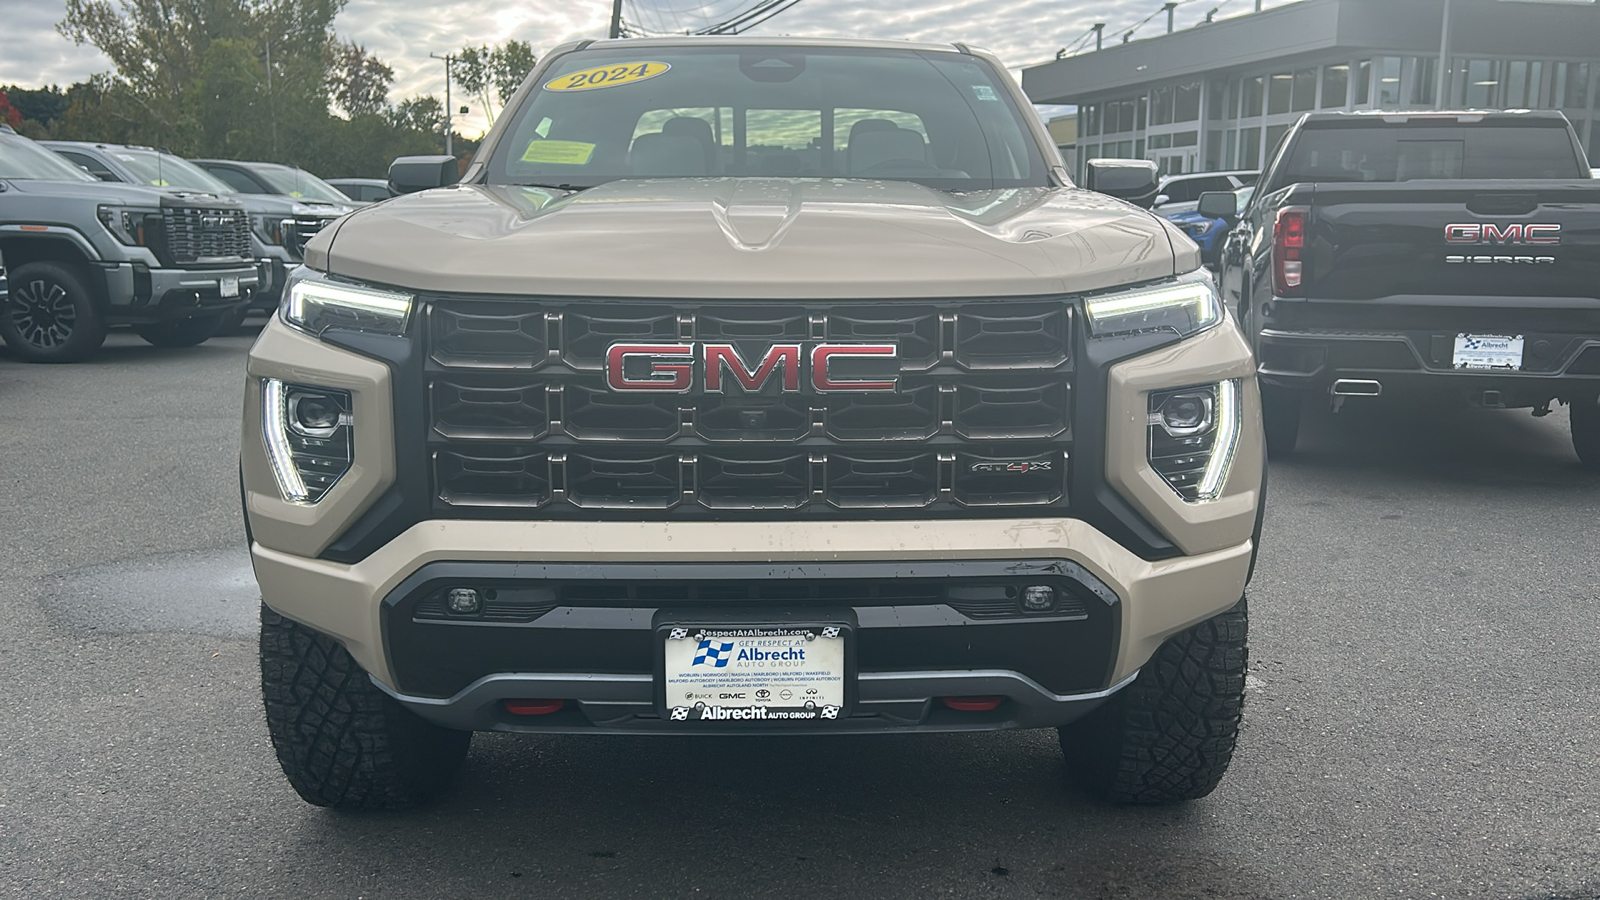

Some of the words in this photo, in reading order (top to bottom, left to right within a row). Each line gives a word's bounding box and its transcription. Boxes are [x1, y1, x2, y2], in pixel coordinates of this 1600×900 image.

[566, 63, 650, 89] 2024
[1445, 223, 1561, 246] GMC
[1445, 255, 1555, 264] SIERRA
[606, 342, 899, 393] GMC
[970, 461, 1052, 474] AT4X
[700, 628, 810, 638] RespectAtAlbrecht.com
[737, 647, 805, 660] Albrecht
[700, 705, 767, 719] Albrecht
